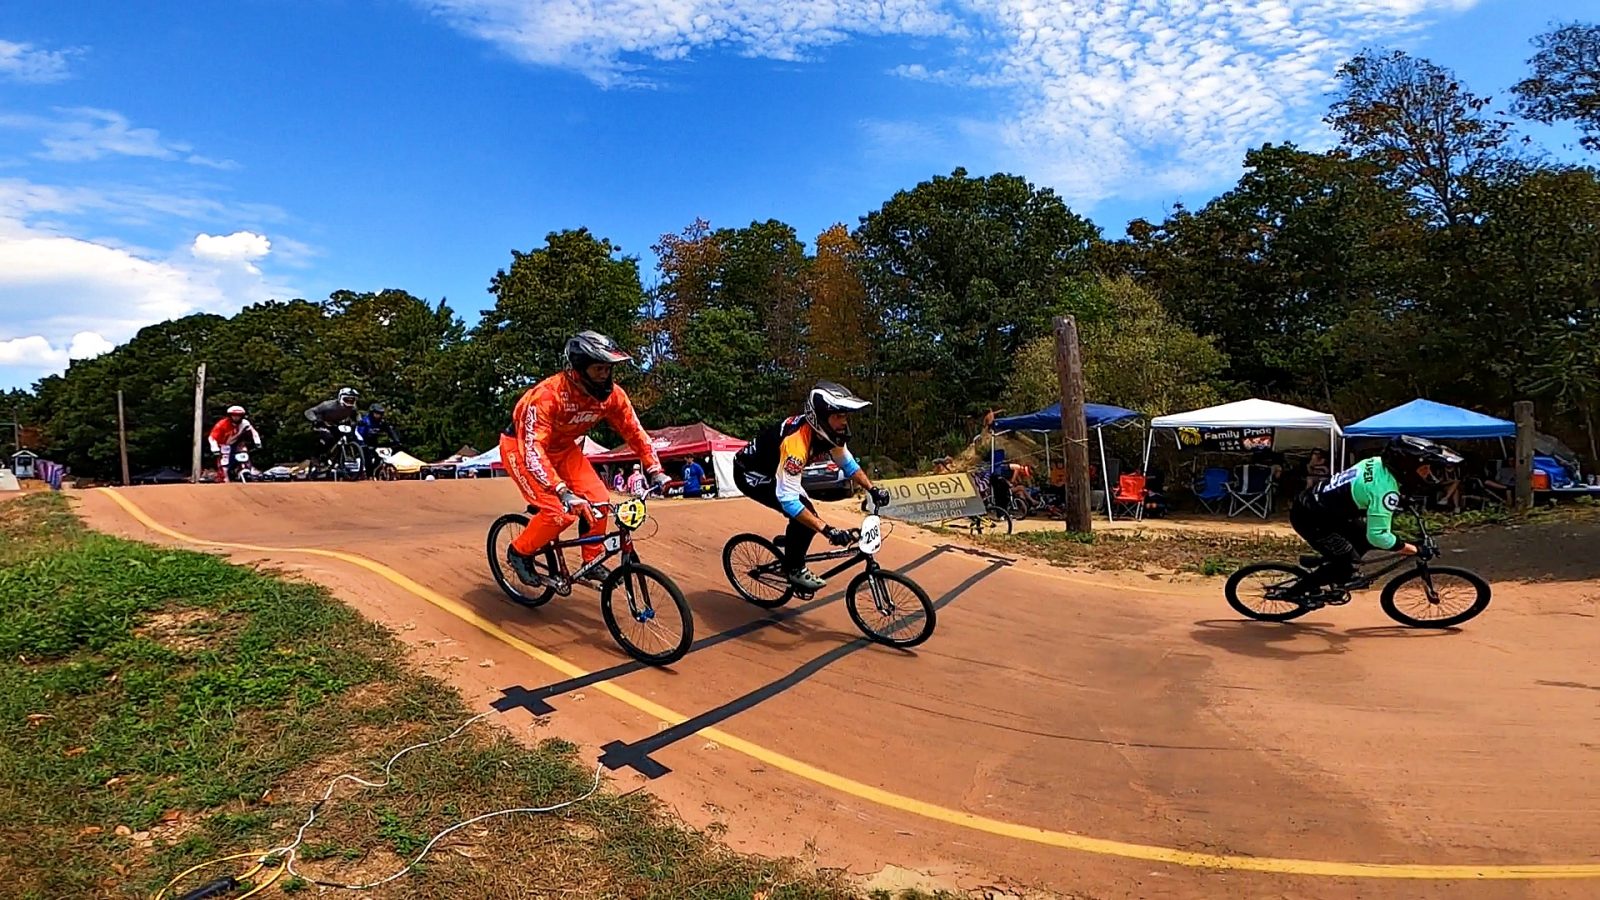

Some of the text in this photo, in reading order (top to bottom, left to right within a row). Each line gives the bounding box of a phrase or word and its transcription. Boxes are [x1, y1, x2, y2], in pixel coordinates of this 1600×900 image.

[1204, 427, 1272, 440] Family Pride
[629, 503, 639, 525] 2
[865, 525, 879, 544] 208
[612, 538, 618, 548] 2
